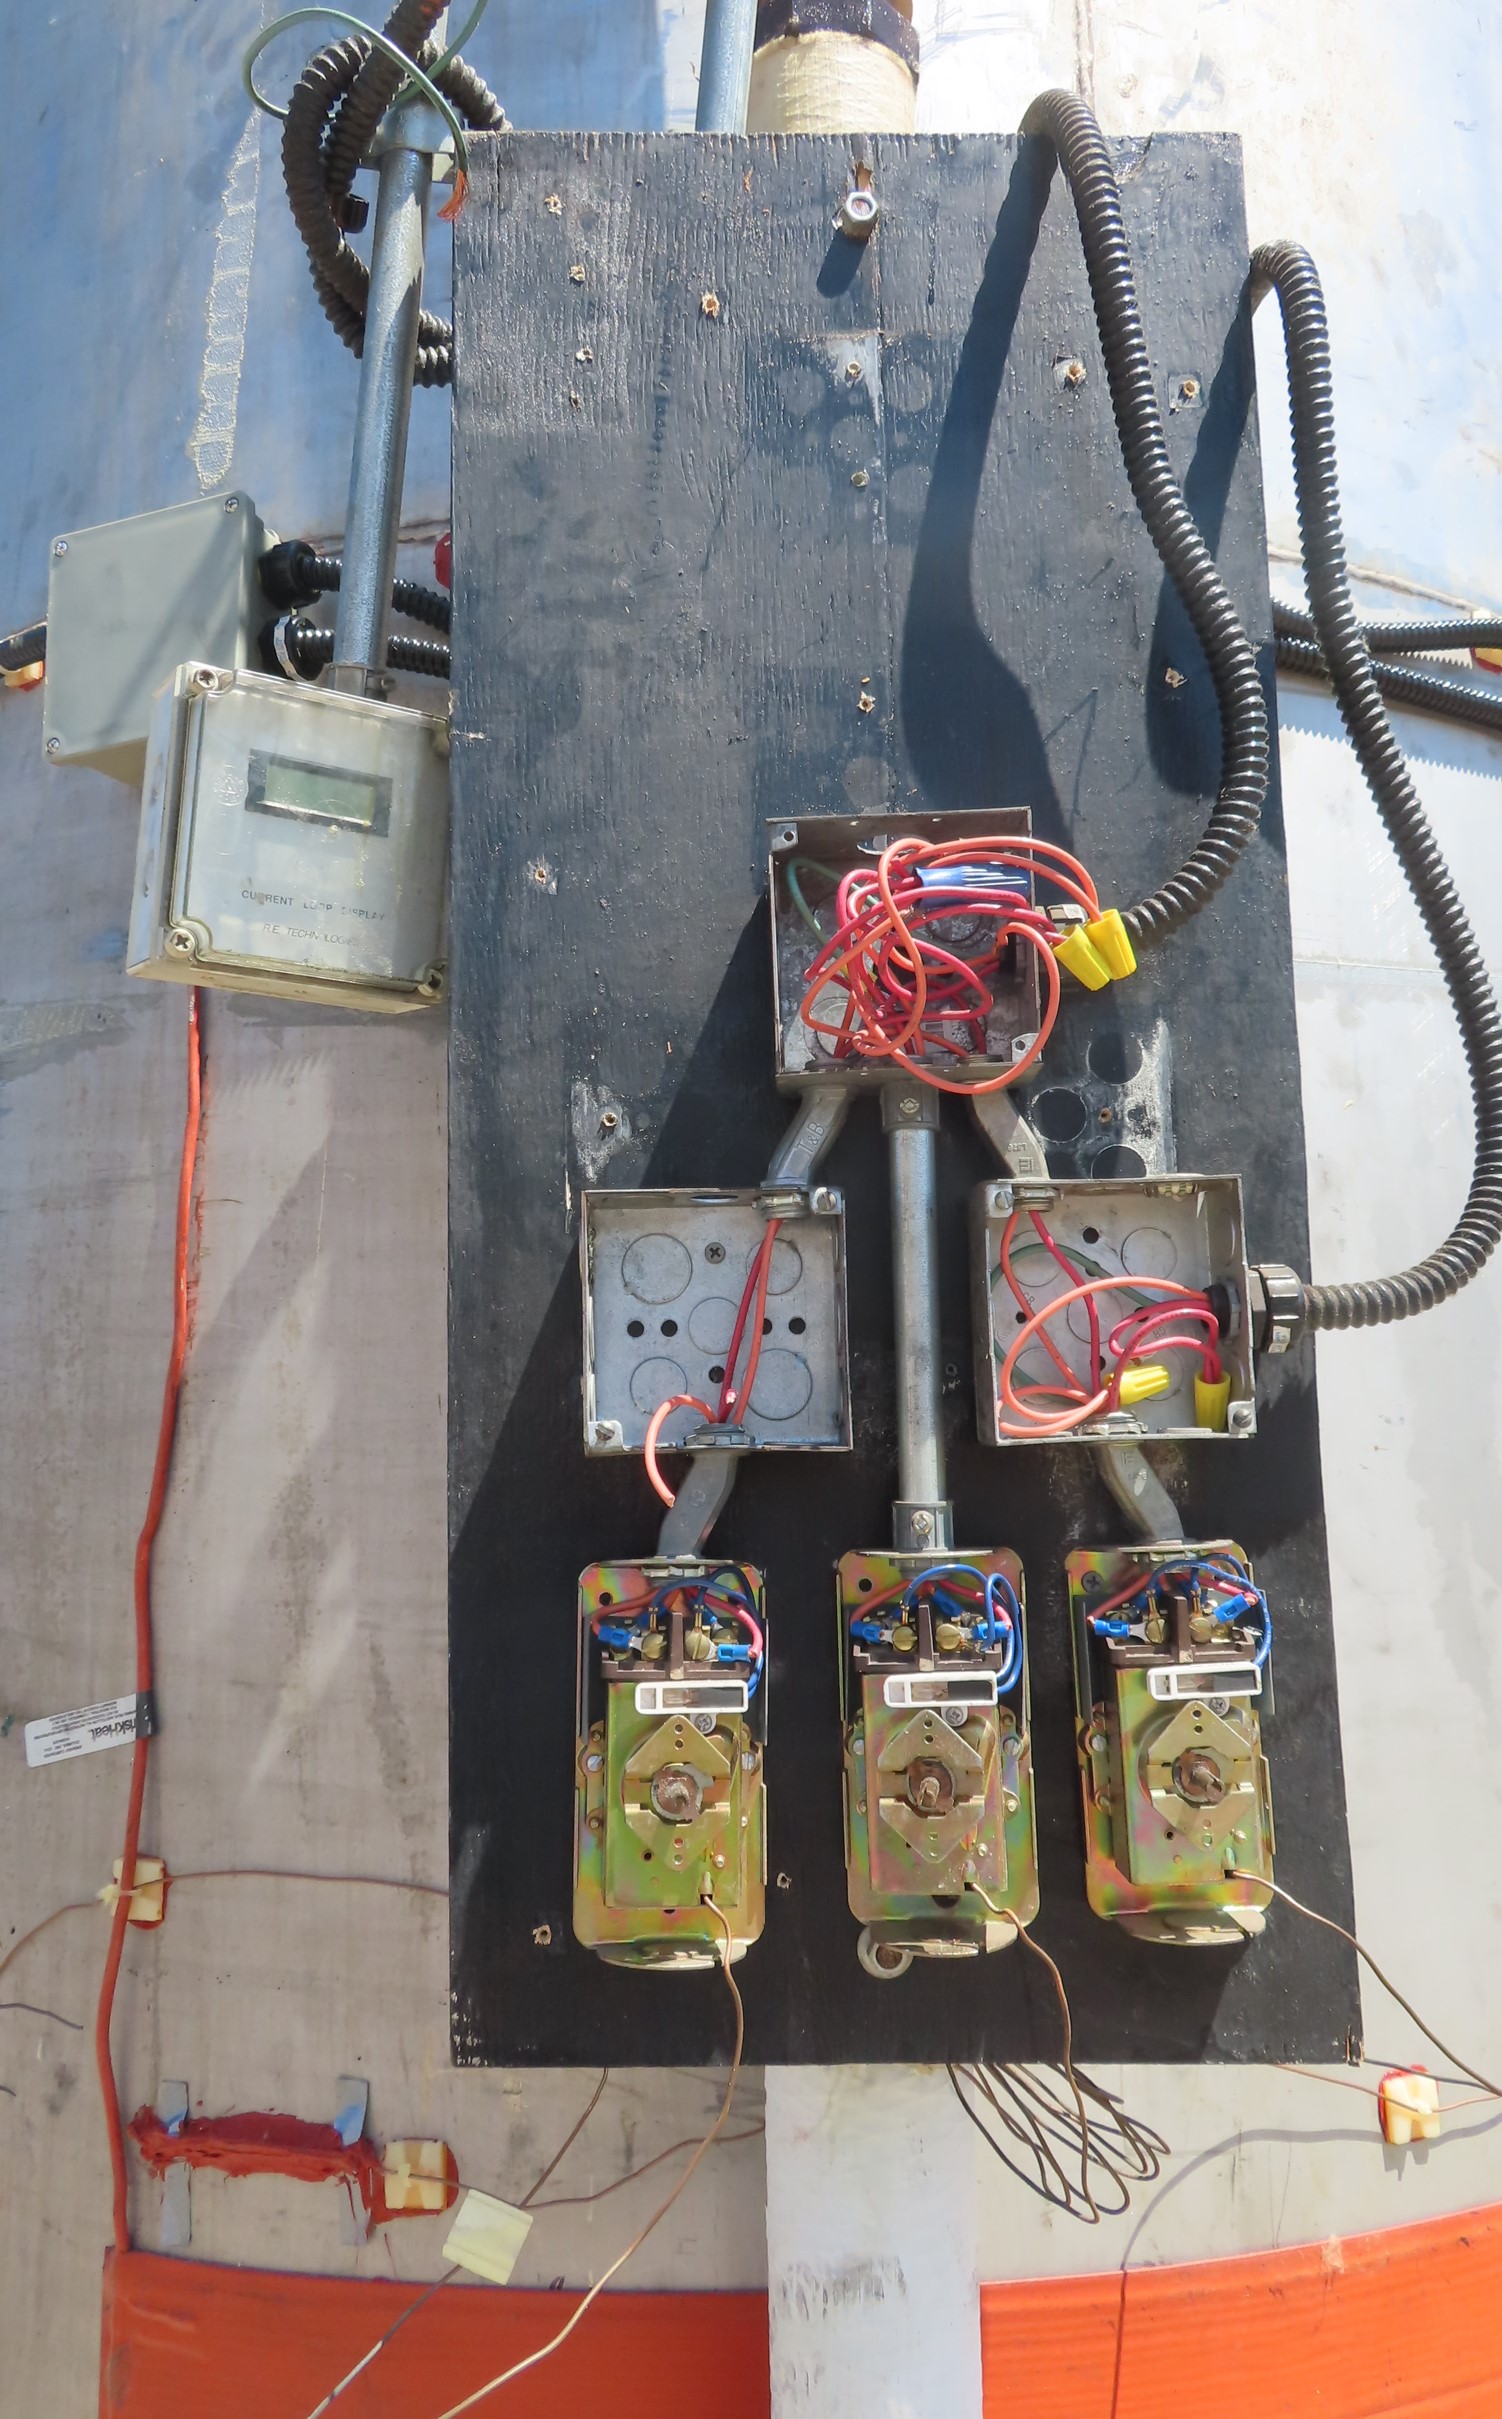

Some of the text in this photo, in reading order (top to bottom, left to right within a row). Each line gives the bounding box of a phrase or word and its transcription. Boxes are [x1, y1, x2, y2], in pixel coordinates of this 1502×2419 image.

[241, 889, 294, 906] CURENT
[287, 927, 360, 947] TECHNLOGIES
[797, 1121, 825, 1154] T&B
[89, 1718, 136, 1742] riskHeat
